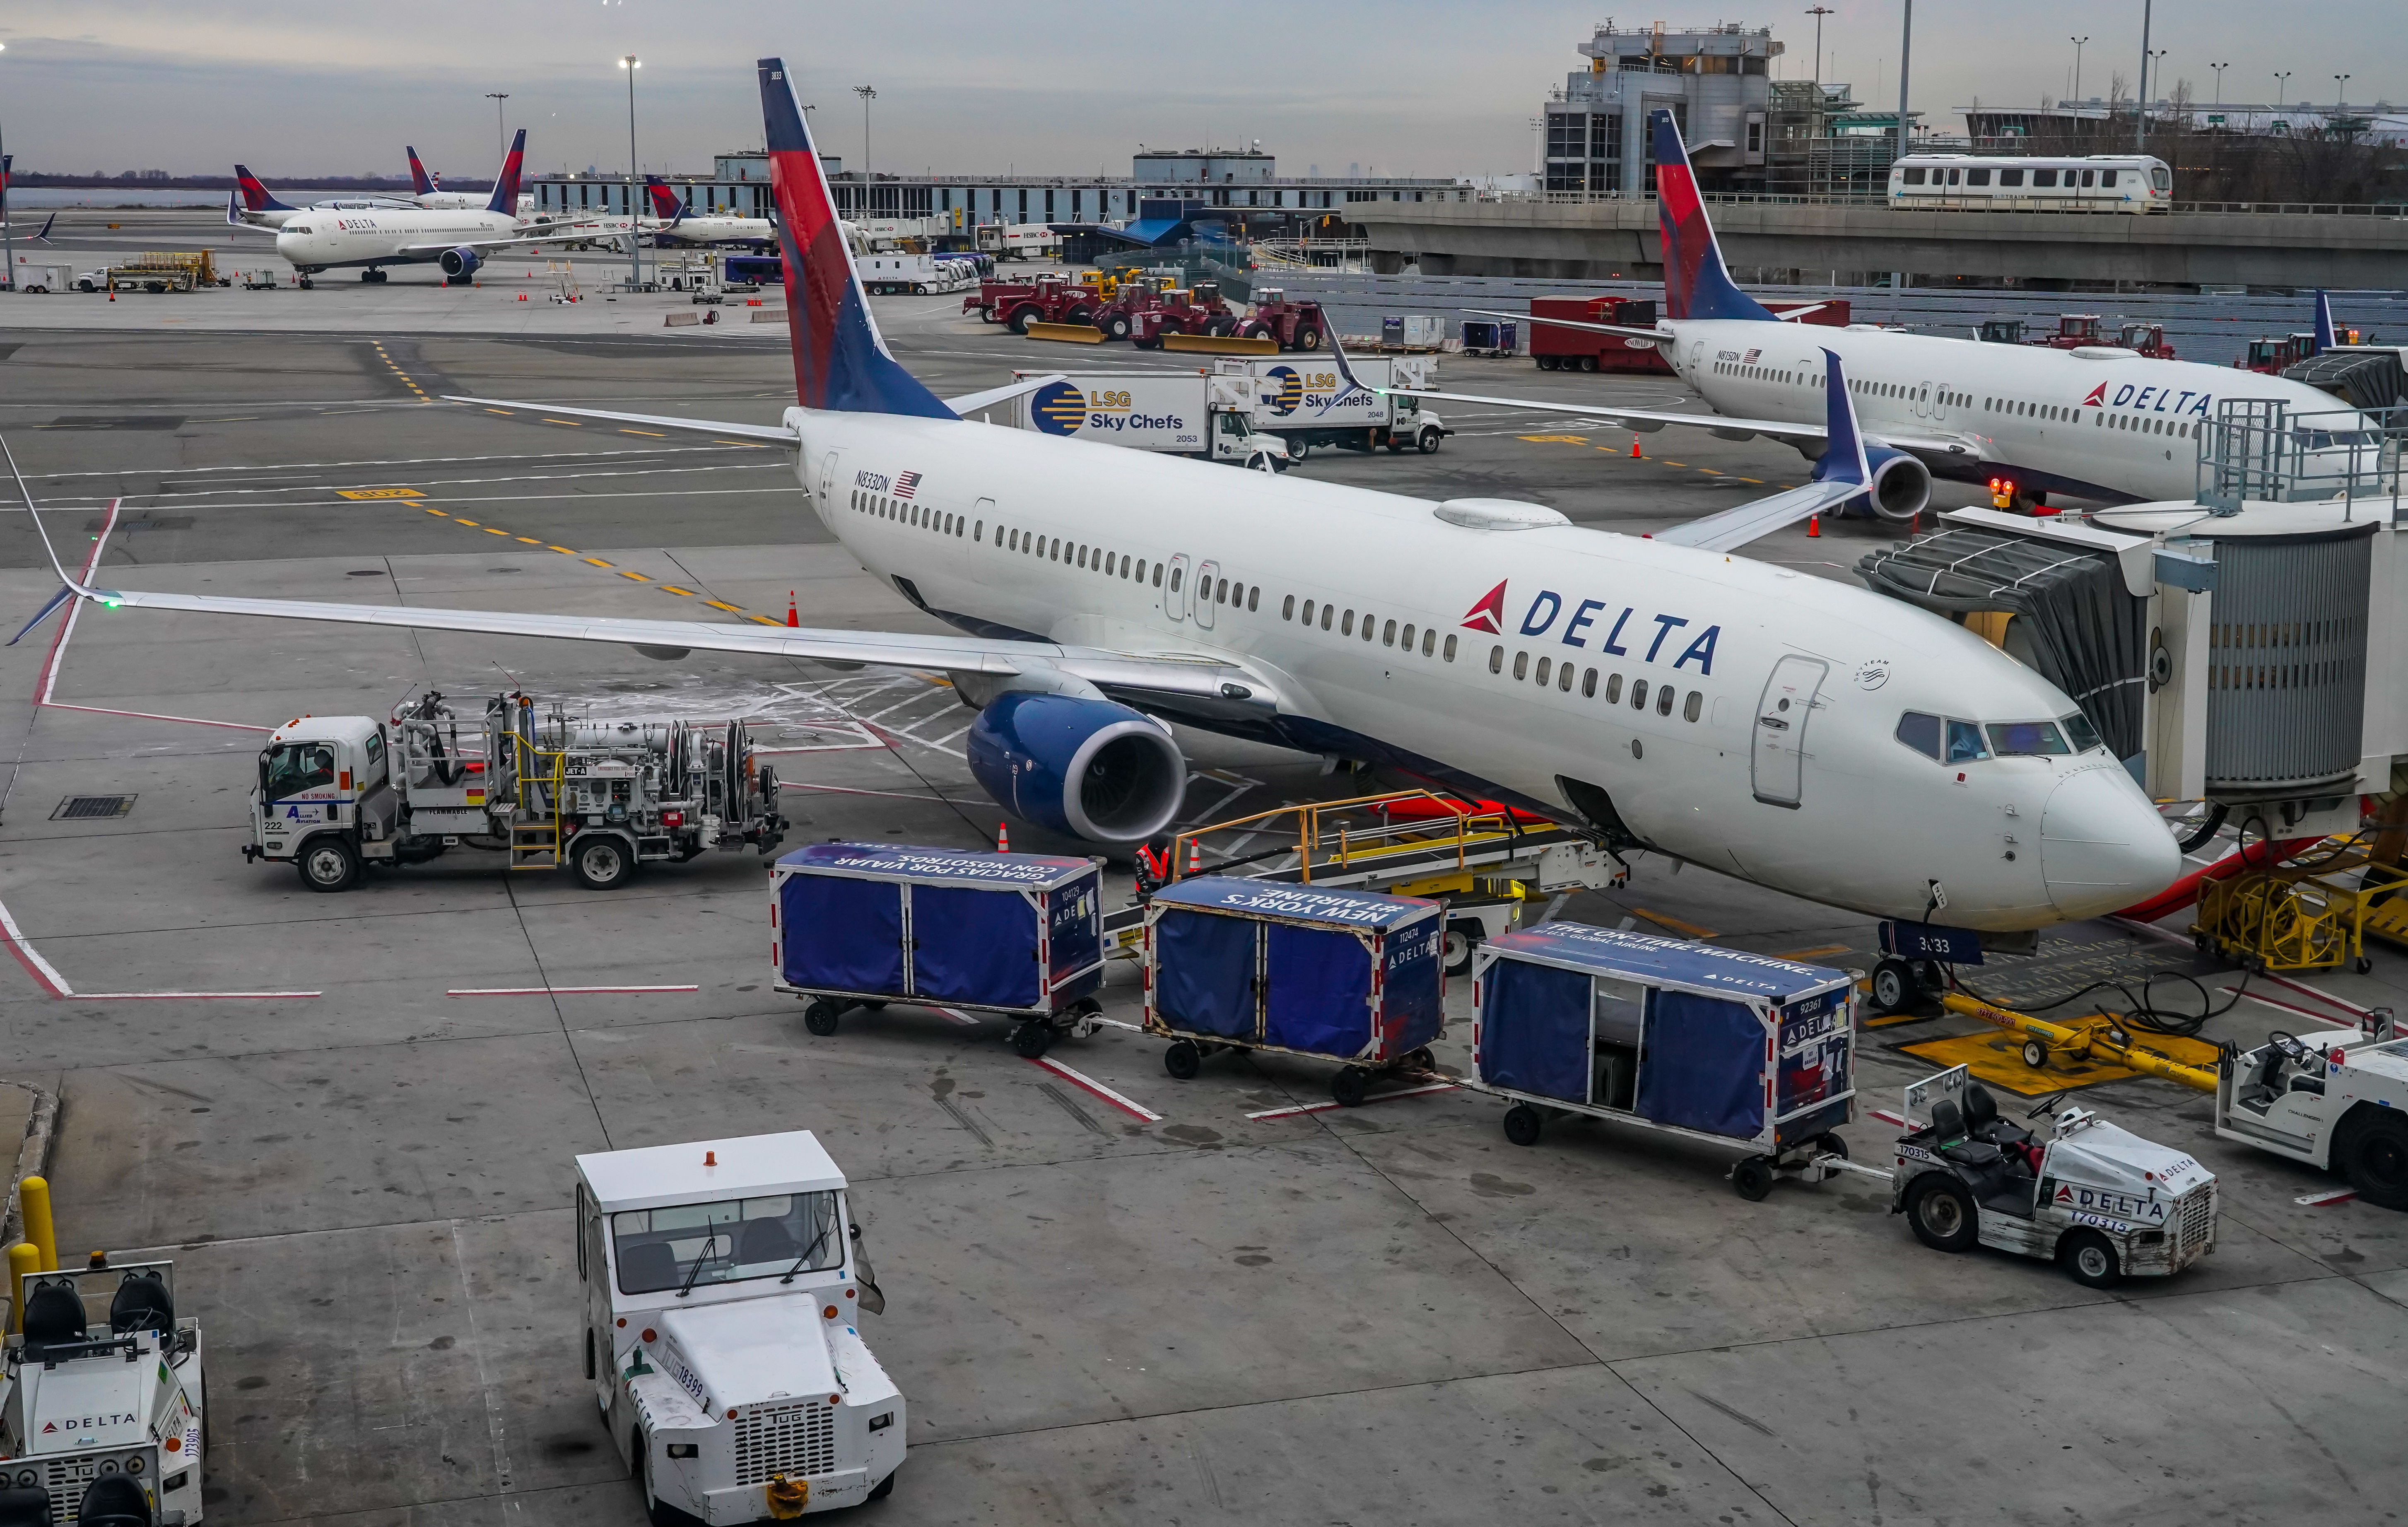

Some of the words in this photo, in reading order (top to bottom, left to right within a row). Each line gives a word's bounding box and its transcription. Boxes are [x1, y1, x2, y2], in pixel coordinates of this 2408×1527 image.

[771, 71, 782, 80] 3833
[345, 220, 377, 228] DELTA
[1626, 338, 1654, 347] SNOWLIFT
[1717, 350, 1741, 362] N815DN
[1306, 373, 1335, 387] LSG
[1091, 391, 1131, 406] LSG
[1305, 394, 1331, 408] Sky
[2113, 384, 2212, 416] DELTA
[1091, 414, 1126, 431] Sky
[1130, 414, 1183, 429] Chefs
[855, 470, 891, 493] N833DN
[1519, 590, 1721, 676] DELTA
[834, 858, 906, 869] VIAJAR
[898, 855, 1011, 871] NOSOTROS.
[909, 864, 955, 874] POR
[1011, 864, 1058, 873] CON
[954, 867, 1045, 880] GRACIAS
[1137, 867, 1149, 890] DELTA
[1062, 886, 1080, 902] 104129
[1259, 889, 1364, 907] AIRLINE.
[1220, 894, 1317, 914] YORK'S
[1366, 903, 1404, 913] #1
[1316, 907, 1389, 923] NEW
[1400, 927, 1418, 943] 112474
[1569, 934, 1613, 944] GLOBAL
[1612, 941, 1661, 952] AIRLINE.
[1399, 941, 1431, 964] DELTA
[1546, 924, 1596, 933] THE
[1593, 931, 1699, 950] ON-TIME
[1694, 948, 1815, 976] MACHINE.
[1721, 977, 1776, 990] DELTA
[1800, 998, 1821, 1015] 92361
[1800, 1014, 1837, 1039] DELA
[1991, 1013, 2016, 1027] 600-900
[1805, 1057, 1817, 1066] BRAKES
[2288, 1110, 2321, 1122] CHALLENGER
[1900, 1145, 1929, 1159] 170315
[2165, 1159, 2196, 1177] DELTA
[2079, 1189, 2164, 1219] DELTA
[2071, 1211, 2129, 1233] 170315
[679, 1366, 703, 1397] 18399
[631, 1388, 654, 1436] DELTA
[765, 1410, 801, 1424] TUG
[66, 1413, 136, 1430] DELTA
[185, 1428, 200, 1459] 173905
